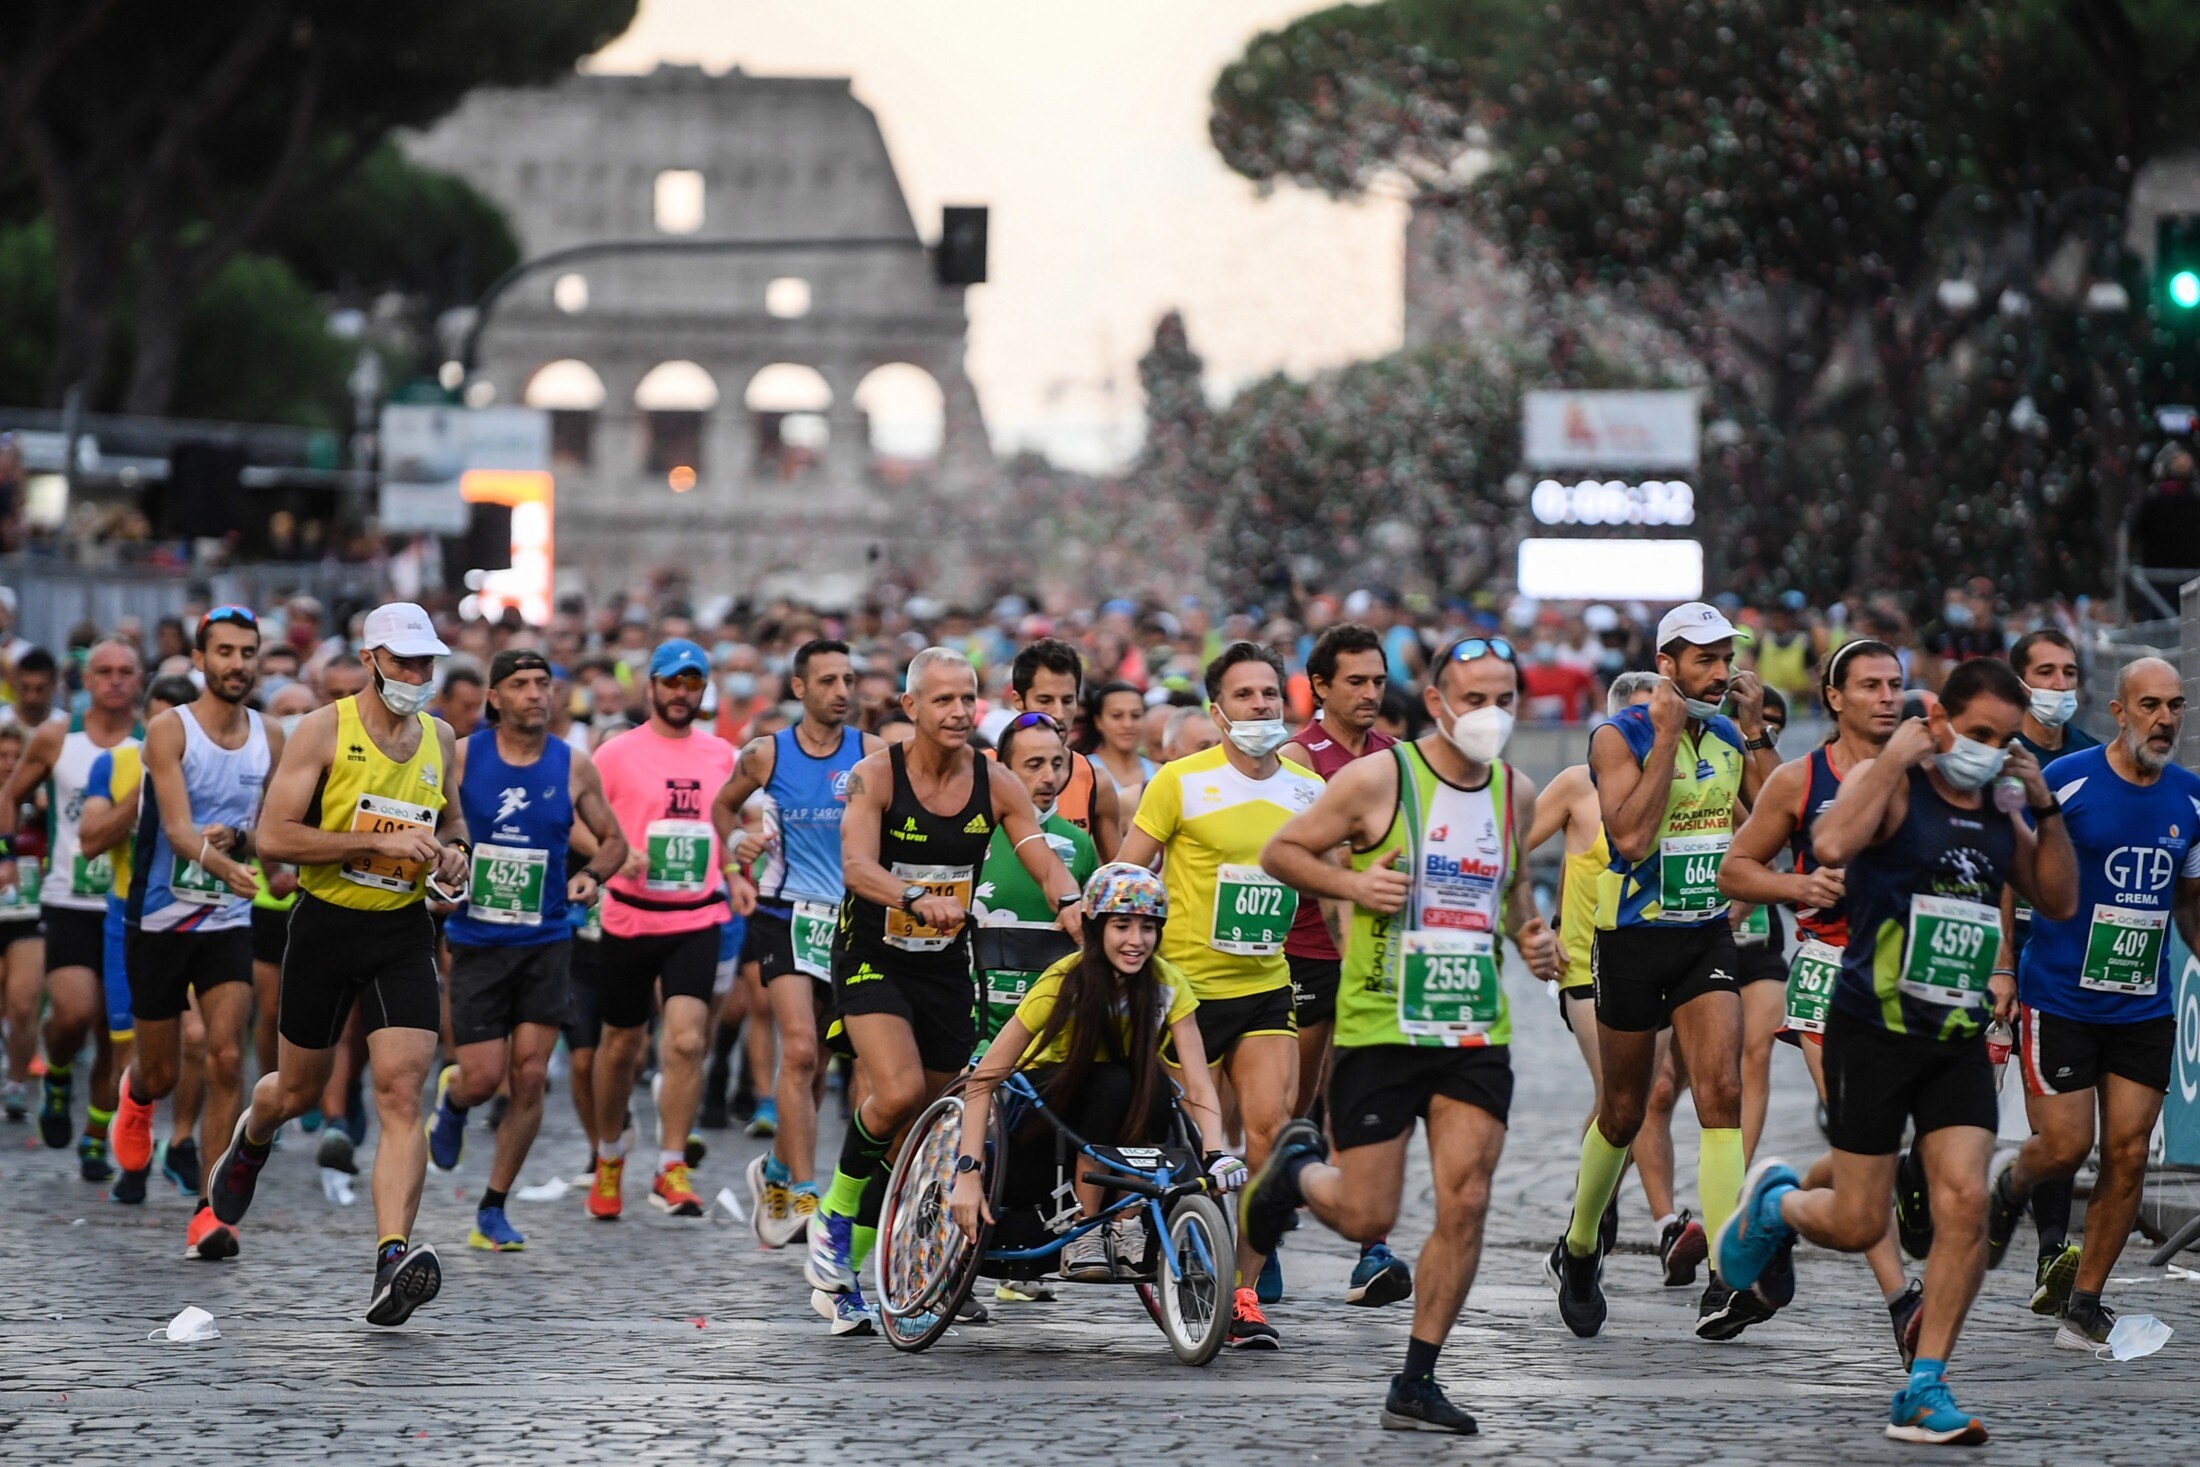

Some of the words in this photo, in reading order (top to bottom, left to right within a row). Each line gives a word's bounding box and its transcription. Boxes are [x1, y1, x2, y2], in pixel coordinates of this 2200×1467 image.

[812, 807, 844, 821] SARO
[665, 837, 695, 860] 615
[1683, 843, 1710, 852] acea
[362, 858, 371, 871] 9
[392, 865, 403, 879] A
[486, 860, 531, 887] 4525
[1425, 854, 1499, 877] BigMat
[1685, 856, 1716, 885] 664
[2104, 846, 2173, 890] GTA
[684, 870, 694, 881] B
[215, 879, 223, 891] B
[483, 895, 492, 906] 7
[511, 899, 522, 910] B
[1235, 886, 1283, 916] 6072
[1680, 898, 1686, 909] 1
[1706, 896, 1716, 909] B
[2115, 892, 2159, 905] CREMA
[1740, 921, 1750, 932] B
[2117, 915, 2147, 927] acea
[904, 924, 913, 936] 9
[1231, 926, 1242, 941] 9
[1262, 928, 1273, 942] B
[1930, 920, 1984, 959] 4599
[2112, 929, 2149, 958] 409
[2107, 957, 2140, 968] GIUSEPPE
[1423, 956, 1481, 990] 2556
[1798, 960, 1836, 995] 561
[1926, 966, 1936, 983] 7
[1957, 973, 1970, 989] B
[2103, 966, 2110, 979] 1
[2131, 970, 2142, 983] B
[988, 976, 995, 989] 2
[1016, 980, 1026, 993] B
[1421, 1004, 1433, 1020] 4
[1459, 1005, 1473, 1021] B
[1791, 1001, 1797, 1016] 1
[1813, 1006, 1825, 1020] B
